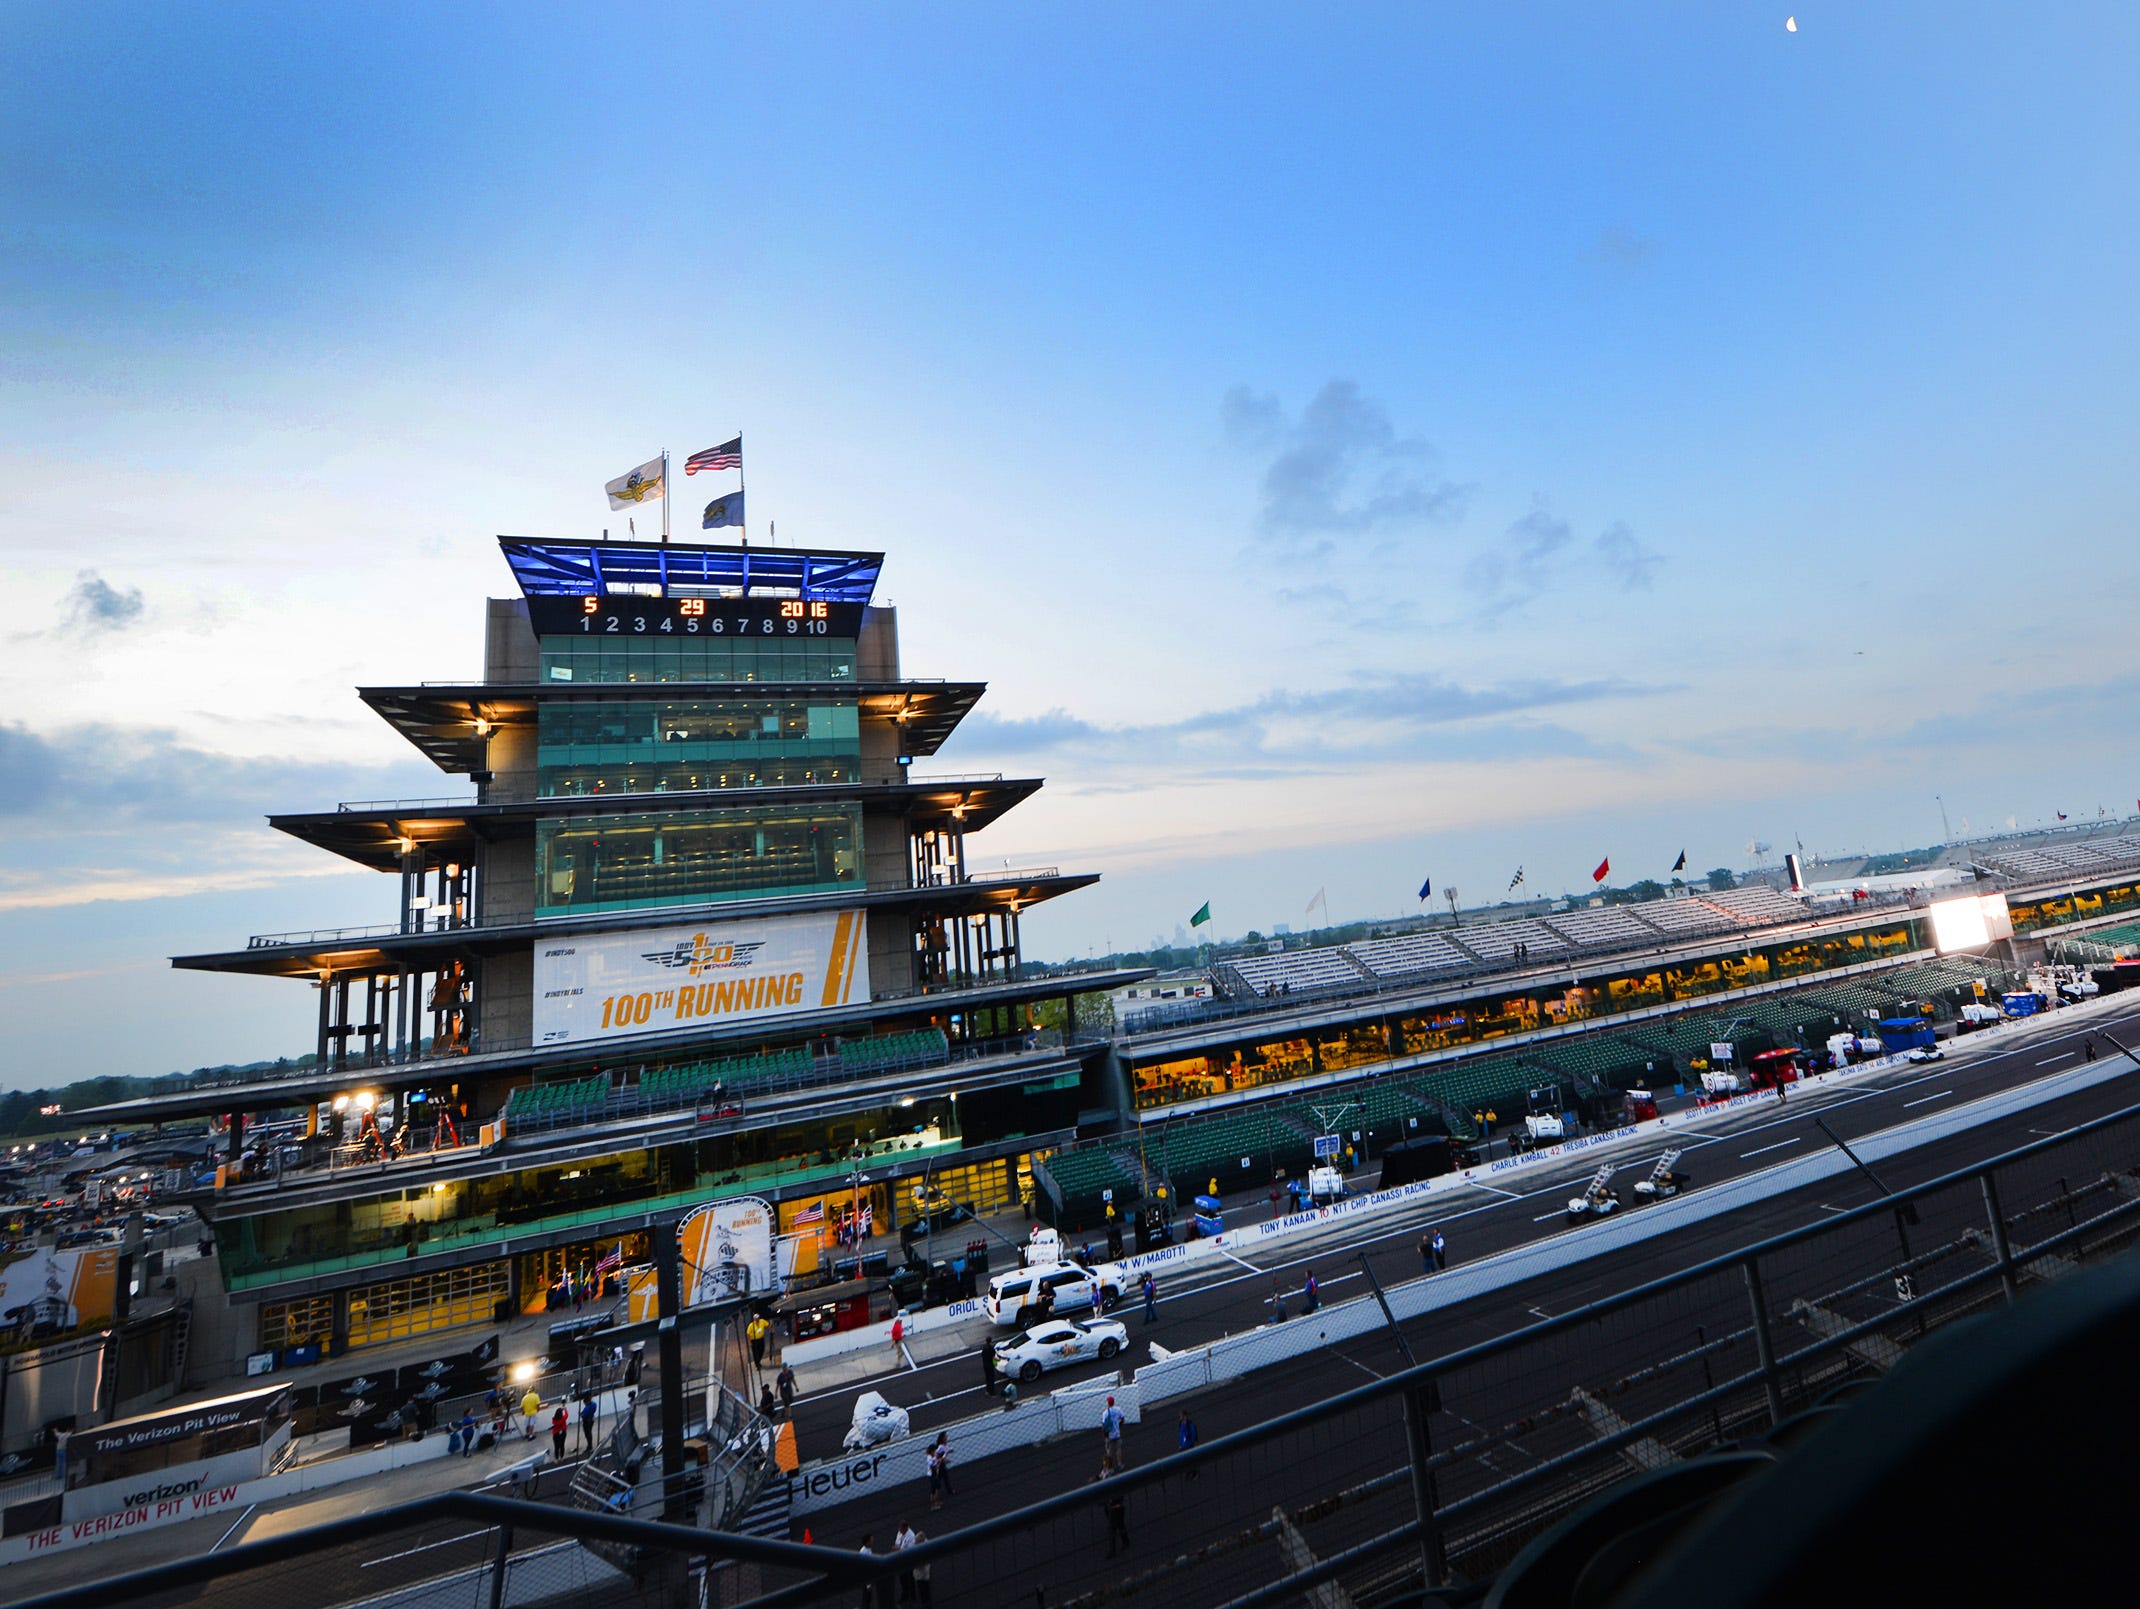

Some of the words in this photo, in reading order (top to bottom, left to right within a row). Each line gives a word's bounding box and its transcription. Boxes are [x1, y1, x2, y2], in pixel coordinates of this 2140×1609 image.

[580, 616, 589, 632] 1
[606, 616, 619, 632] 2
[634, 616, 646, 632] 3
[660, 617, 673, 632] 4
[687, 618, 699, 632] 5
[712, 618, 724, 633] 6
[738, 619, 749, 633] 7
[763, 619, 774, 634] 8
[786, 619, 798, 634] 9
[806, 620, 827, 634] 10
[584, 597, 597, 613] 5
[680, 599, 705, 615] 29
[601, 989, 674, 1029] 100TH
[675, 973, 804, 1020] RUNNING
[1491, 1156, 1518, 1173] CHARLIE
[1520, 1150, 1548, 1164] KIMBALL
[1550, 1146, 1560, 1156] 42
[1563, 1138, 1588, 1153] TRESIBA
[1616, 1126, 1638, 1138] RACING
[1259, 1220, 1281, 1235] TONY
[1283, 1211, 1316, 1228] KANAAN
[1320, 1208, 1329, 1219] 10
[1332, 1203, 1349, 1216] NTT
[1351, 1197, 1368, 1210] CHIP
[1404, 1181, 1431, 1196] RACING
[949, 1300, 979, 1317] ORIOL
[1131, 1245, 1186, 1269] W/MAROTTI
[96, 1437, 123, 1451] The
[127, 1424, 181, 1446] Verizon
[184, 1418, 204, 1432] Pit
[207, 1410, 241, 1427] View
[123, 1477, 200, 1508] verizon
[787, 1454, 887, 1504] Heuer
[27, 1526, 62, 1551] THE
[72, 1508, 148, 1540] VERIZON
[157, 1498, 184, 1520] PIT
[192, 1485, 238, 1511] VIEW
